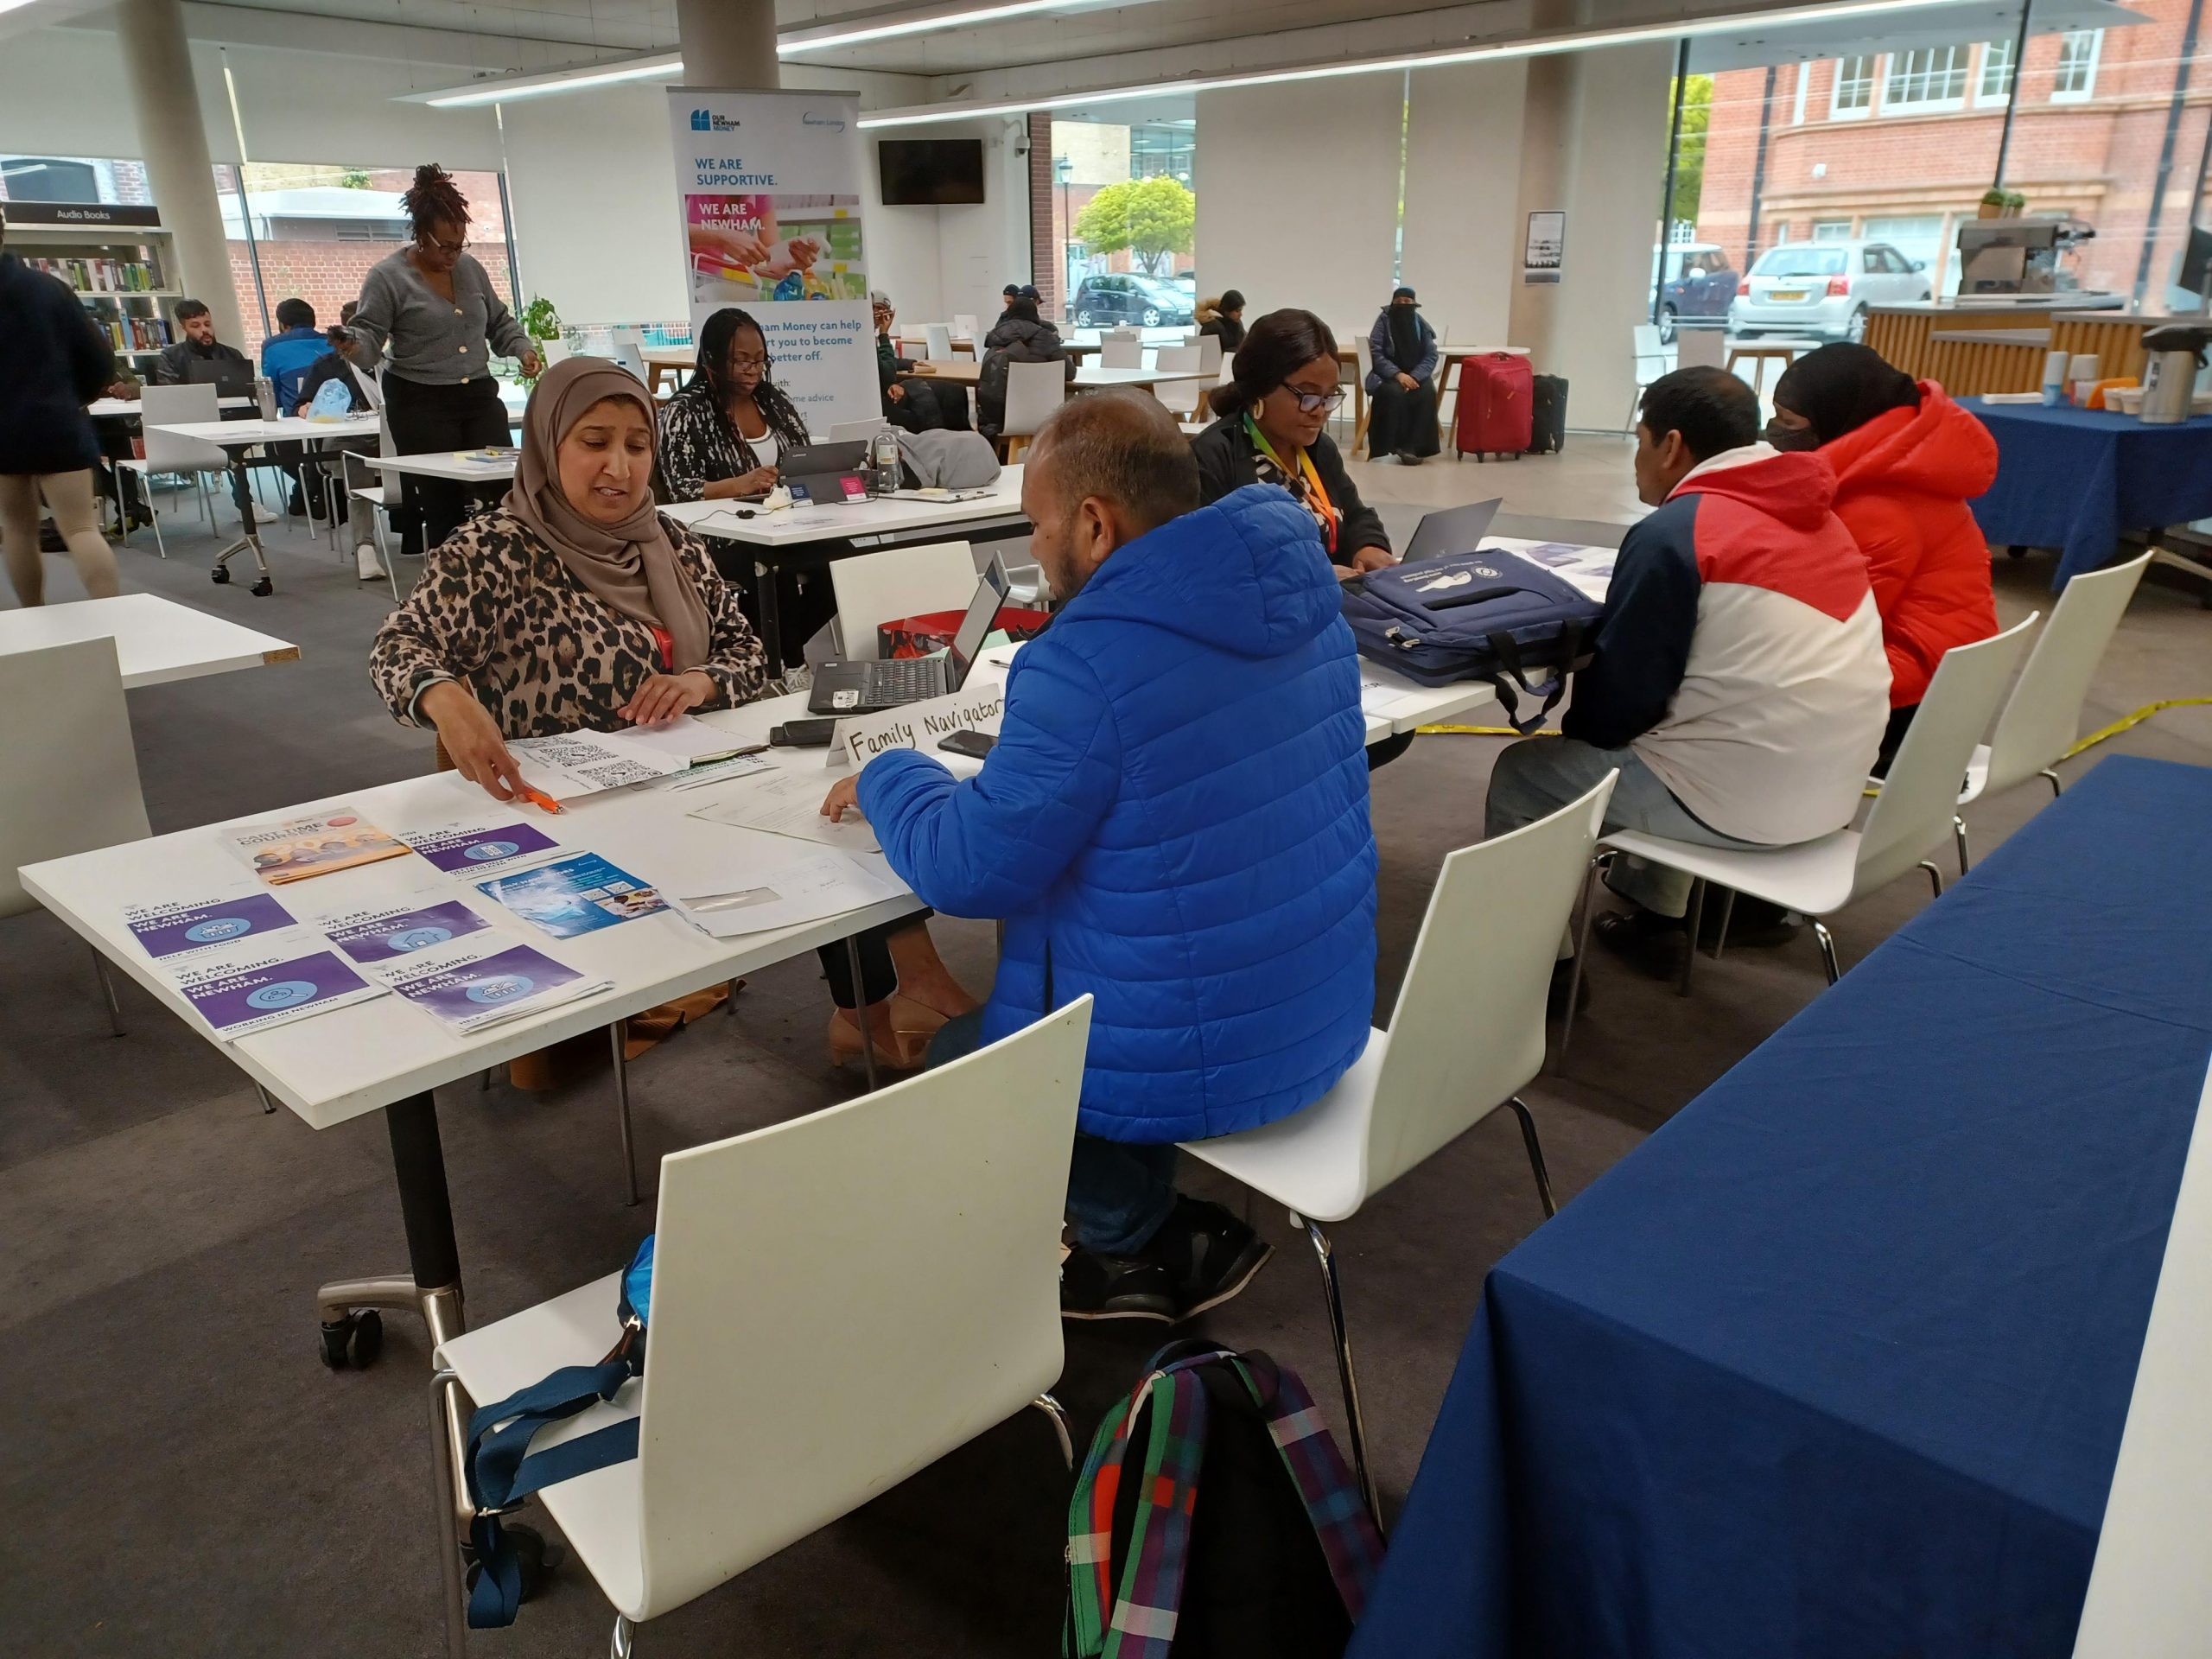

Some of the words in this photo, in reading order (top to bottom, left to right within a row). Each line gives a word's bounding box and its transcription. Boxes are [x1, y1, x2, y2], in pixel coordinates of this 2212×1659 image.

[696, 159, 715, 169] WE
[719, 159, 742, 170] ARE
[696, 175, 778, 186] SUPPORTIVE.
[57, 210, 82, 219] Audio
[84, 211, 111, 219] Books
[699, 203, 719, 214] WE
[722, 203, 747, 215] ARE
[701, 219, 766, 231] NEWHAM.
[783, 322, 817, 333] Money
[841, 320, 861, 332] help
[779, 339, 798, 349] you
[813, 336, 852, 346] become
[771, 353, 802, 361] better
[805, 351, 823, 361] off.
[849, 722, 916, 761] Family
[924, 698, 1005, 734] Navigator
[237, 830, 281, 842] PART
[283, 822, 324, 835] TIME
[405, 834, 427, 842] WE
[410, 827, 490, 846] WELCOMING.
[416, 842, 440, 851] WE
[423, 839, 484, 855] NEWHAM.
[125, 907, 145, 916] WE
[153, 901, 181, 911] ARE
[129, 898, 226, 921] WELCOMING.
[345, 910, 371, 919] ARE
[133, 918, 156, 928] WE
[162, 912, 191, 921] ARE
[137, 913, 213, 933] NEWHAM.
[330, 929, 358, 938] WE
[359, 922, 385, 931] ARE
[336, 922, 409, 943] NEWHAM.
[175, 969, 202, 980] WE
[206, 962, 236, 973] ARE
[181, 957, 284, 985] WELCOMING.
[381, 966, 406, 979] WE
[408, 960, 435, 971] ARE
[187, 982, 214, 993] WE
[217, 975, 248, 987] ARE
[192, 976, 274, 1000] NEWHAM.
[399, 982, 424, 992] WE
[429, 972, 456, 983] ARE
[408, 973, 482, 998] NEWHAM.
[222, 1014, 275, 1033] WORKING
[291, 997, 339, 1014] NEWHAM
